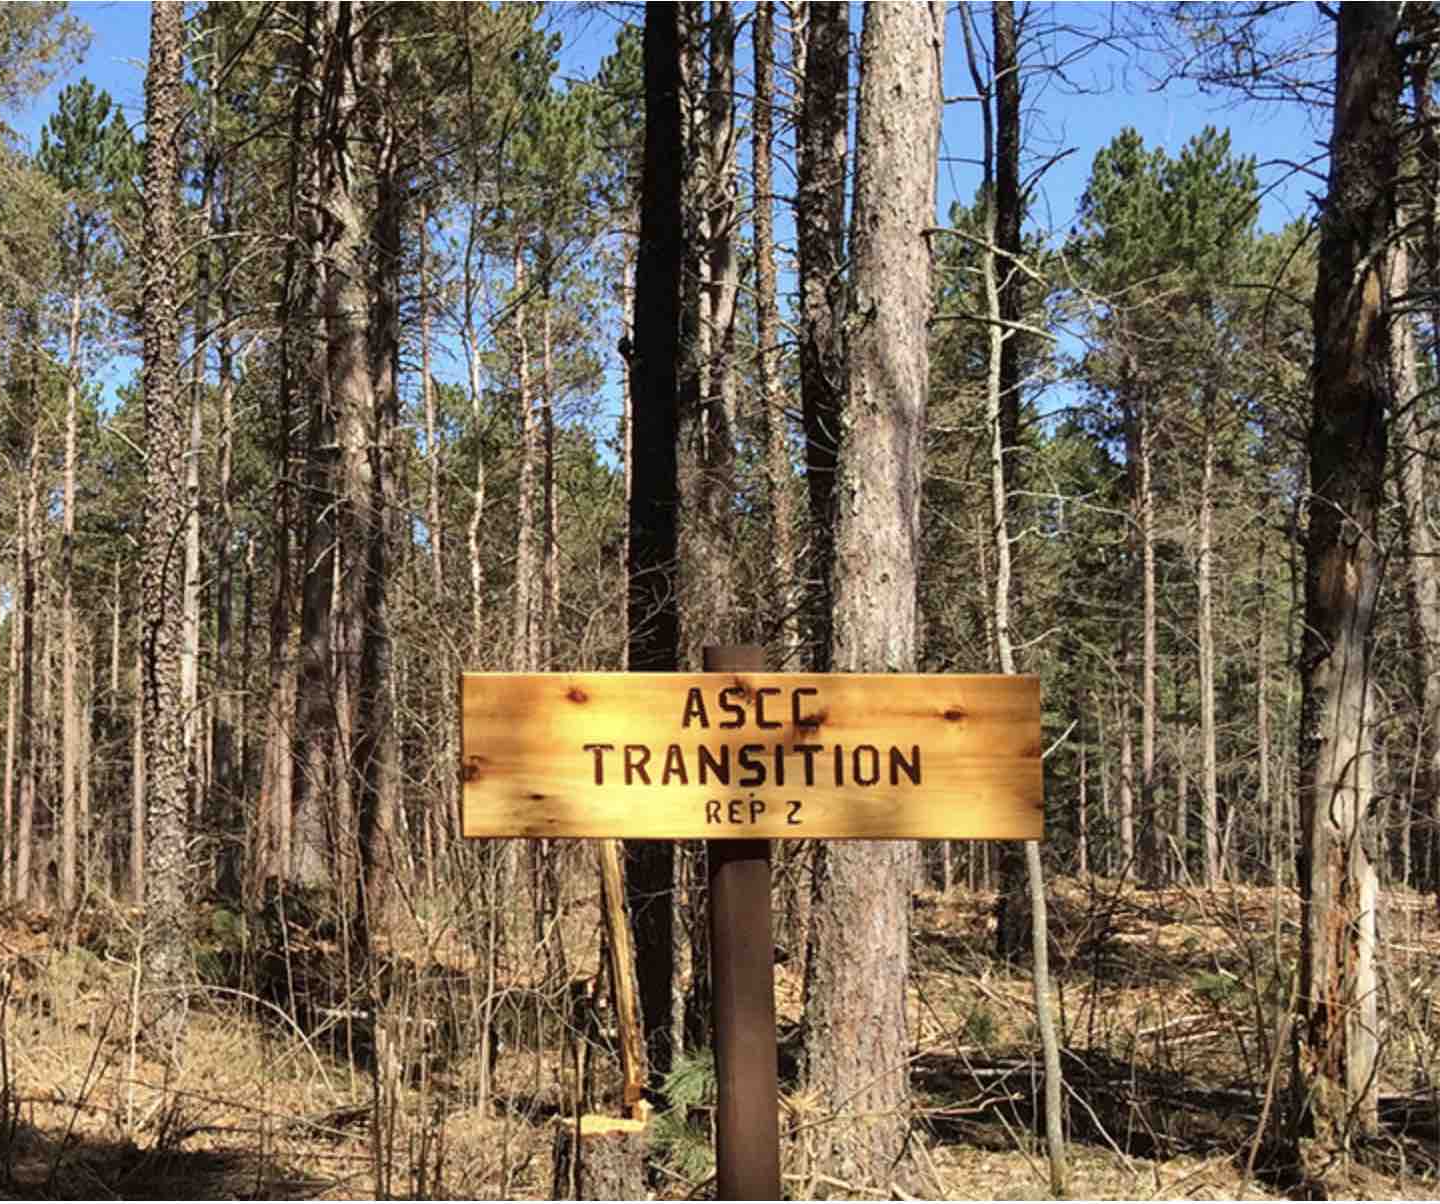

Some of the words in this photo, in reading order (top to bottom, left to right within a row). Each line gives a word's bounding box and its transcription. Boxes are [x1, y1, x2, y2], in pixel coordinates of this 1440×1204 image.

[681, 687, 820, 729] ASCC
[582, 743, 923, 787] TRANSITION
[705, 800, 765, 825] REP
